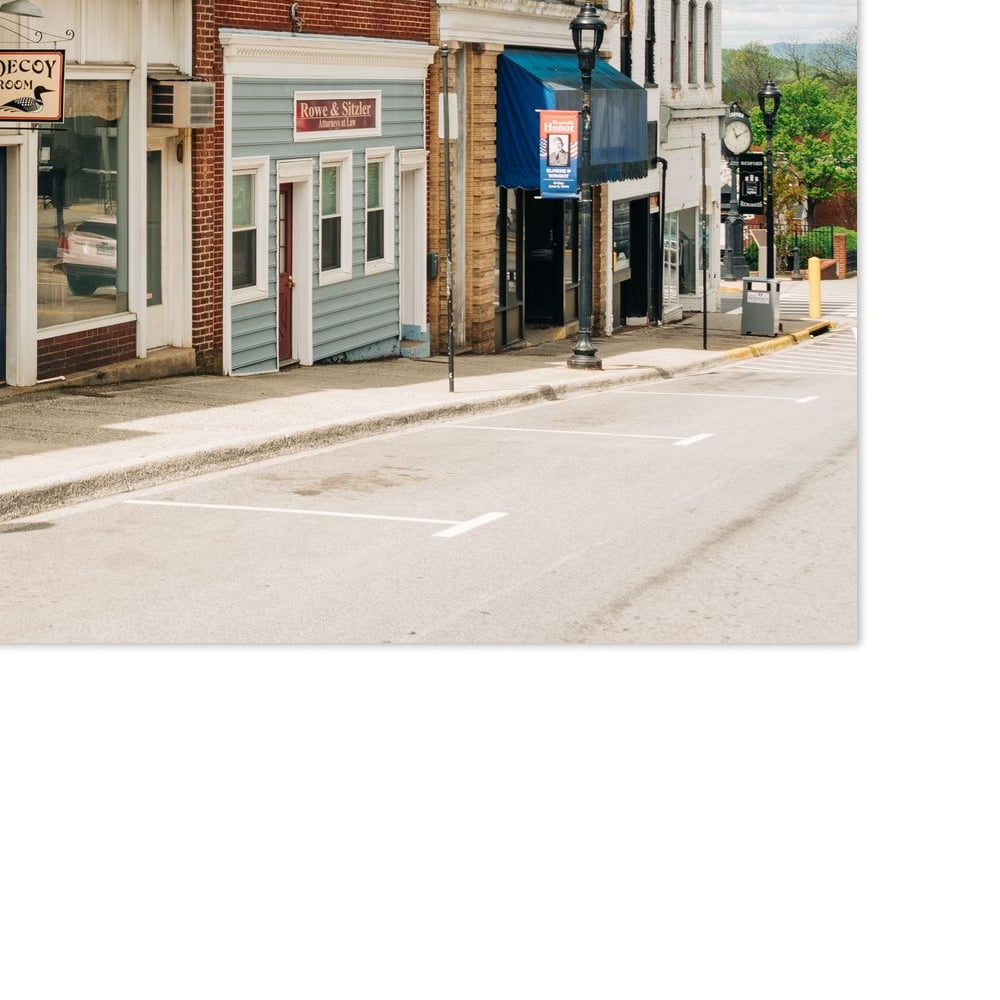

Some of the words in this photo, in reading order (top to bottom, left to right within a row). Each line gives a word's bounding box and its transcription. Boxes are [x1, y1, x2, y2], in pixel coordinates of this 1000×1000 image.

[300, 102, 328, 118] Rowe
[330, 101, 340, 117] &
[342, 100, 372, 116] Sitzler
[318, 119, 340, 129] Attorneys
[341, 119, 346, 128] at
[347, 118, 356, 127] Law
